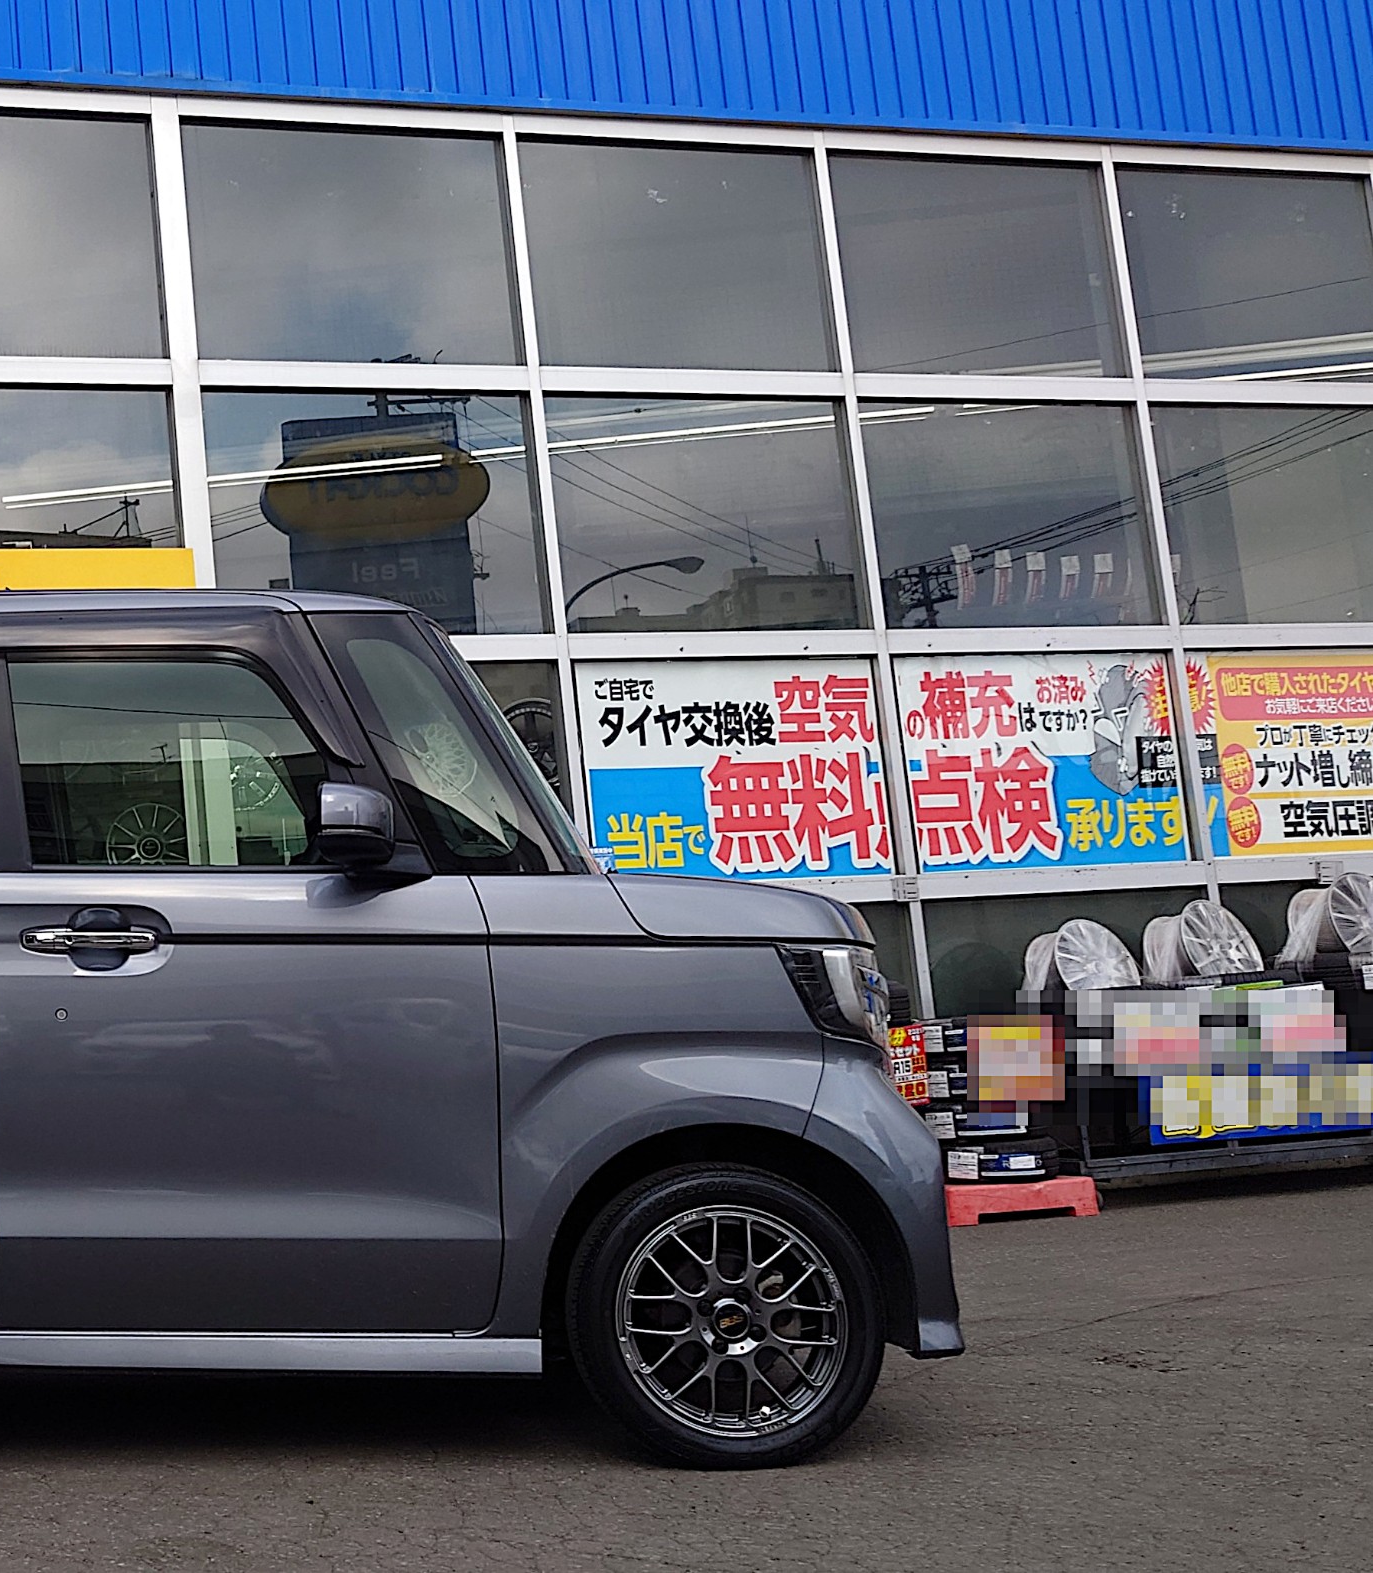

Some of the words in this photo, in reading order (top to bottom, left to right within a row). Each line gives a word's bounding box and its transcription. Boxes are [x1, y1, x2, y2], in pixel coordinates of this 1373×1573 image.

[594, 678, 654, 701] ご自宅で
[607, 811, 705, 869] 当店で
